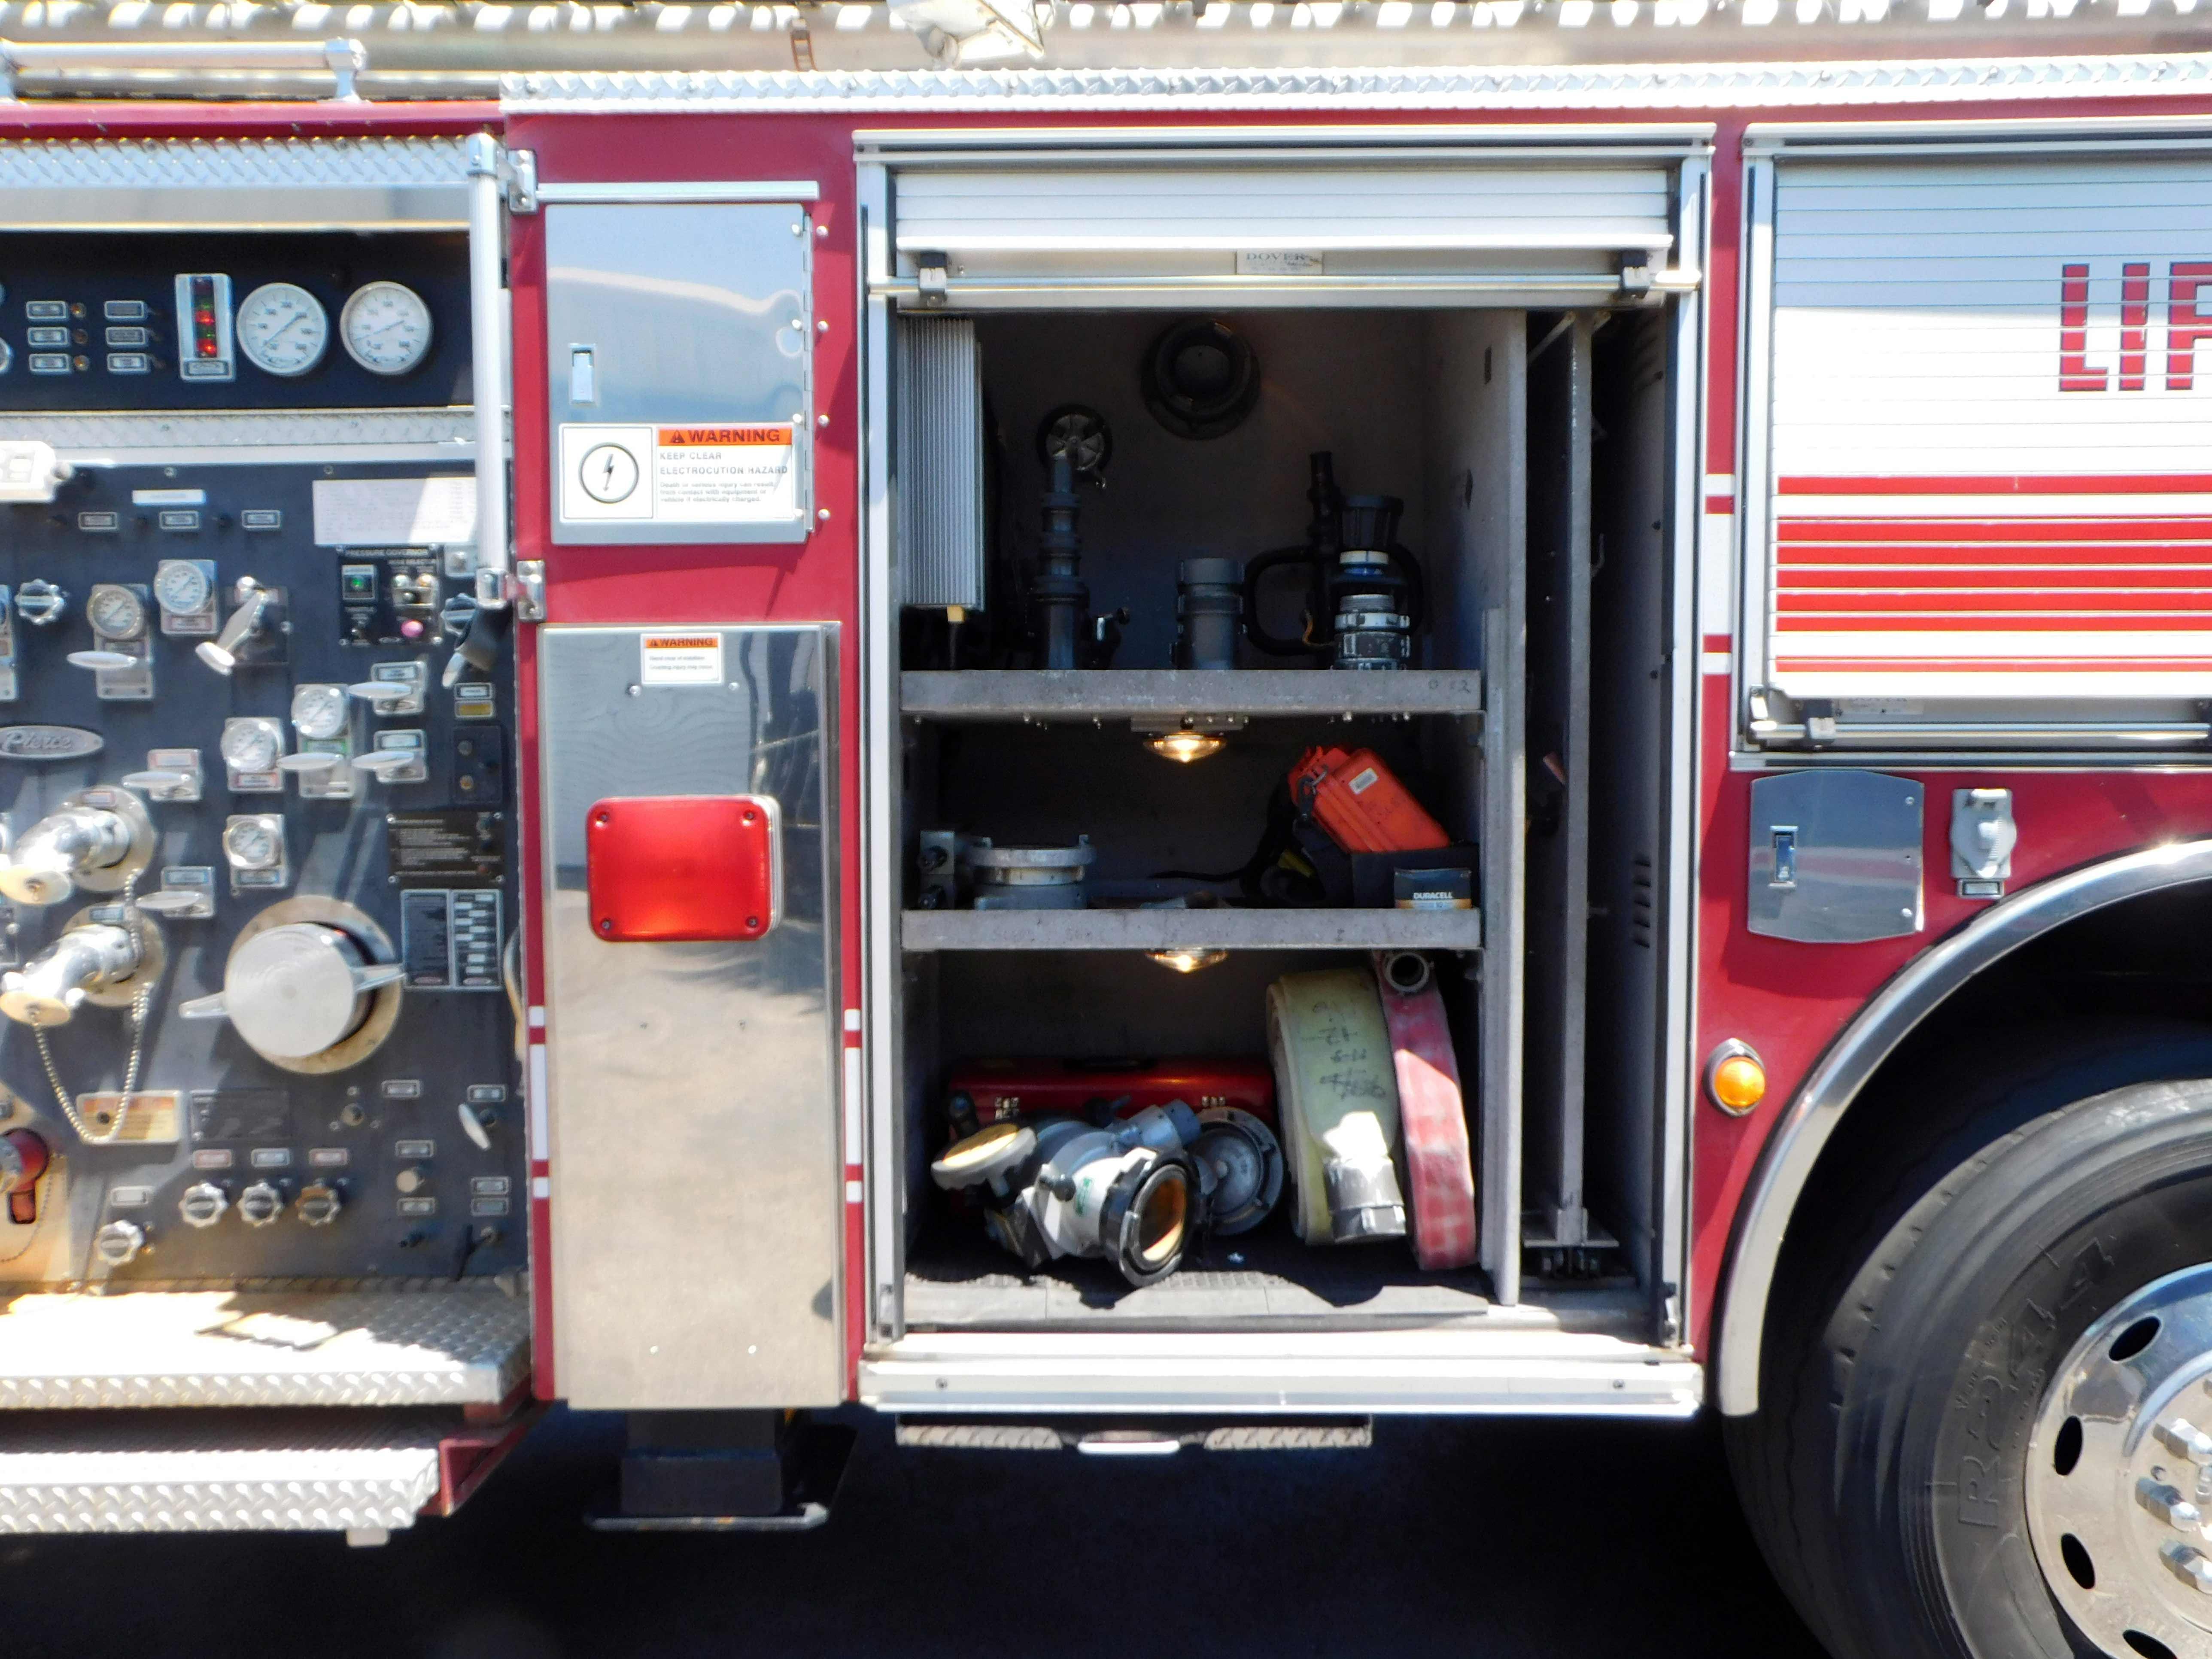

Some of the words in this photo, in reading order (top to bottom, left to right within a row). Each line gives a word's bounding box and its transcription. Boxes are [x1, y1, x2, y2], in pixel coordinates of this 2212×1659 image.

[688, 428, 780, 443] WARNING
[660, 452, 685, 460] KEEP
[660, 466, 744, 474] ELECTROCUTION
[748, 466, 788, 474] HAZARD
[659, 638, 713, 647] WARNING
[2, 730, 73, 752] Pierce
